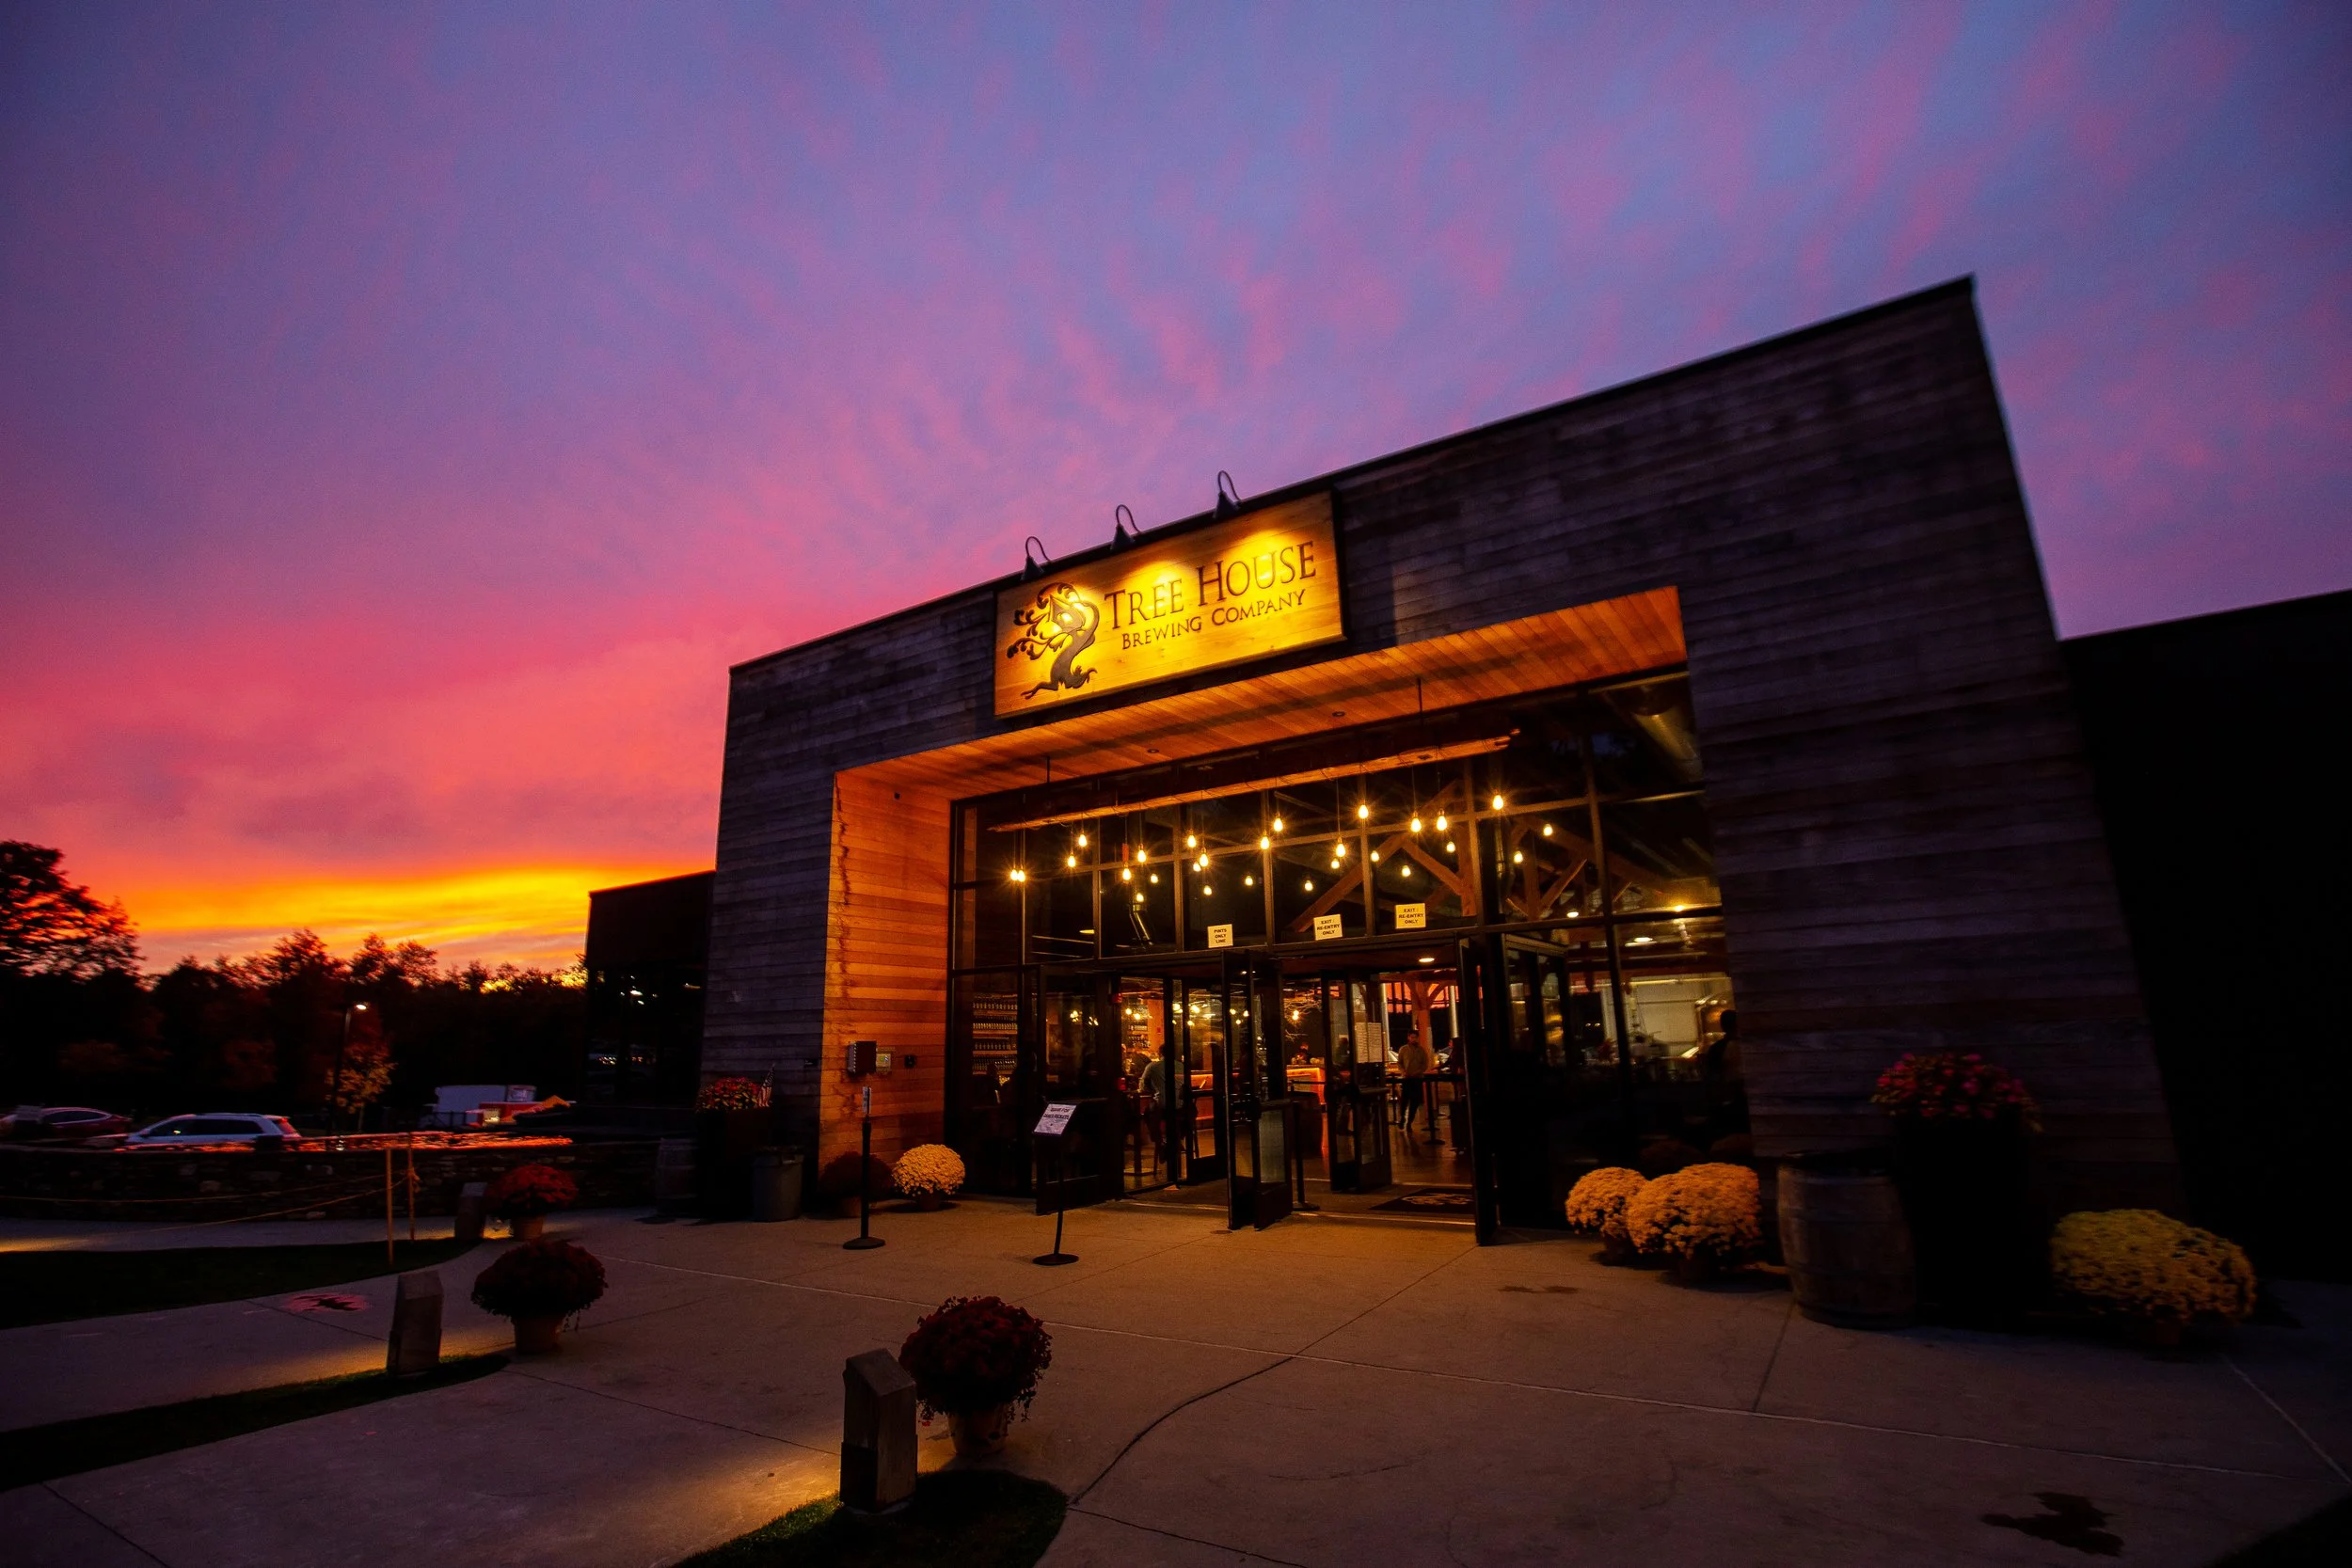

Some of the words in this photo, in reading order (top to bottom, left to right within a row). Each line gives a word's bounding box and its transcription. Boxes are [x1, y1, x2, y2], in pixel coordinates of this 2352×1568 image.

[1104, 578, 1184, 630] TREE
[1195, 540, 1317, 607] HOUSE
[1121, 616, 1202, 650] BREWING
[1211, 588, 1306, 626] COMPANY
